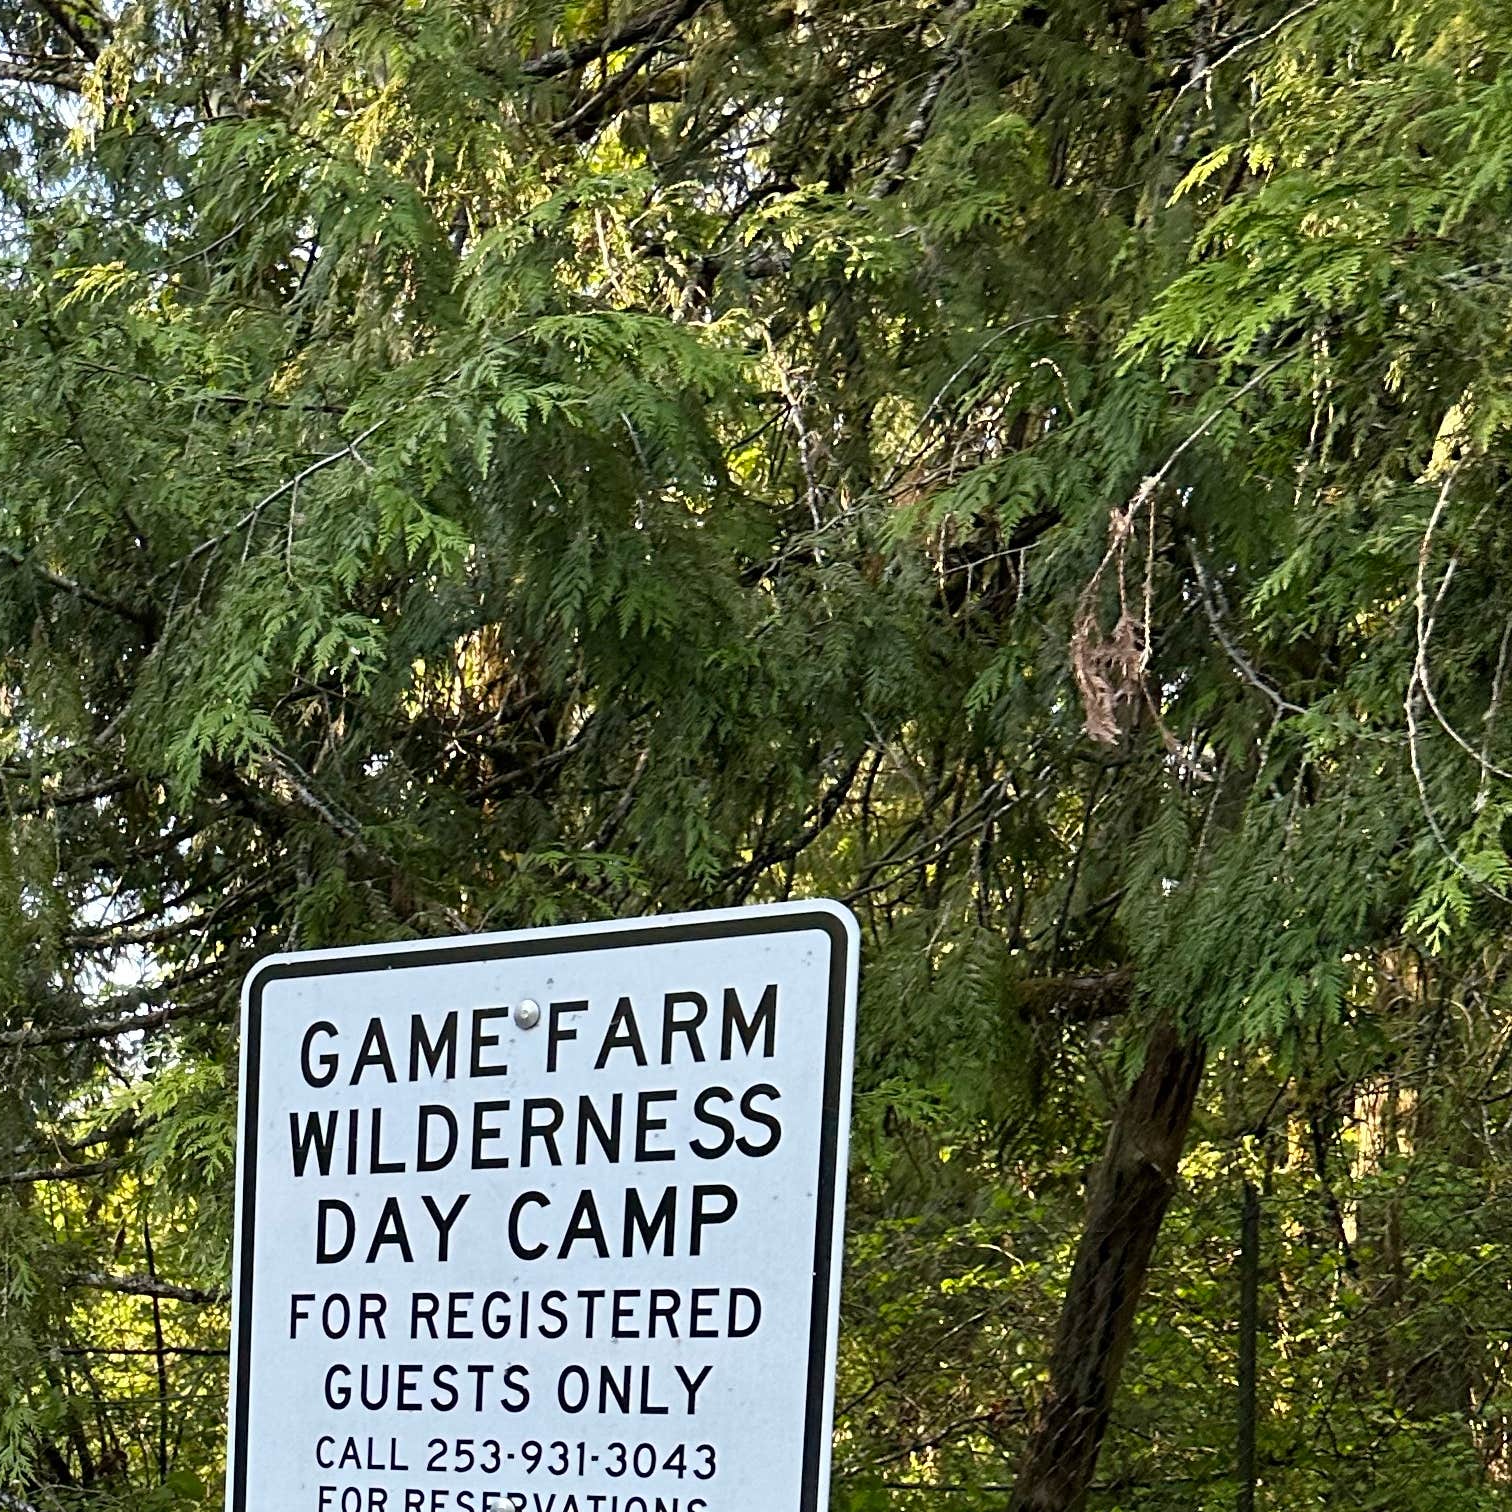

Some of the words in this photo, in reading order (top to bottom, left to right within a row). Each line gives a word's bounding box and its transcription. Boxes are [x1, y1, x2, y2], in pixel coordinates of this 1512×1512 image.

[300, 1006, 509, 1089] GAME
[546, 983, 778, 1073] FARM
[289, 1083, 782, 1178] WILDERNESS
[316, 1193, 472, 1265] DAY
[507, 1184, 738, 1261] CAMP
[289, 1292, 387, 1340] FOR
[410, 1287, 762, 1340] REGISTERED
[324, 1363, 531, 1413] GUESTS
[557, 1364, 714, 1416] ONLY
[316, 1435, 409, 1472] CALL
[426, 1438, 717, 1480] 253-931-3043
